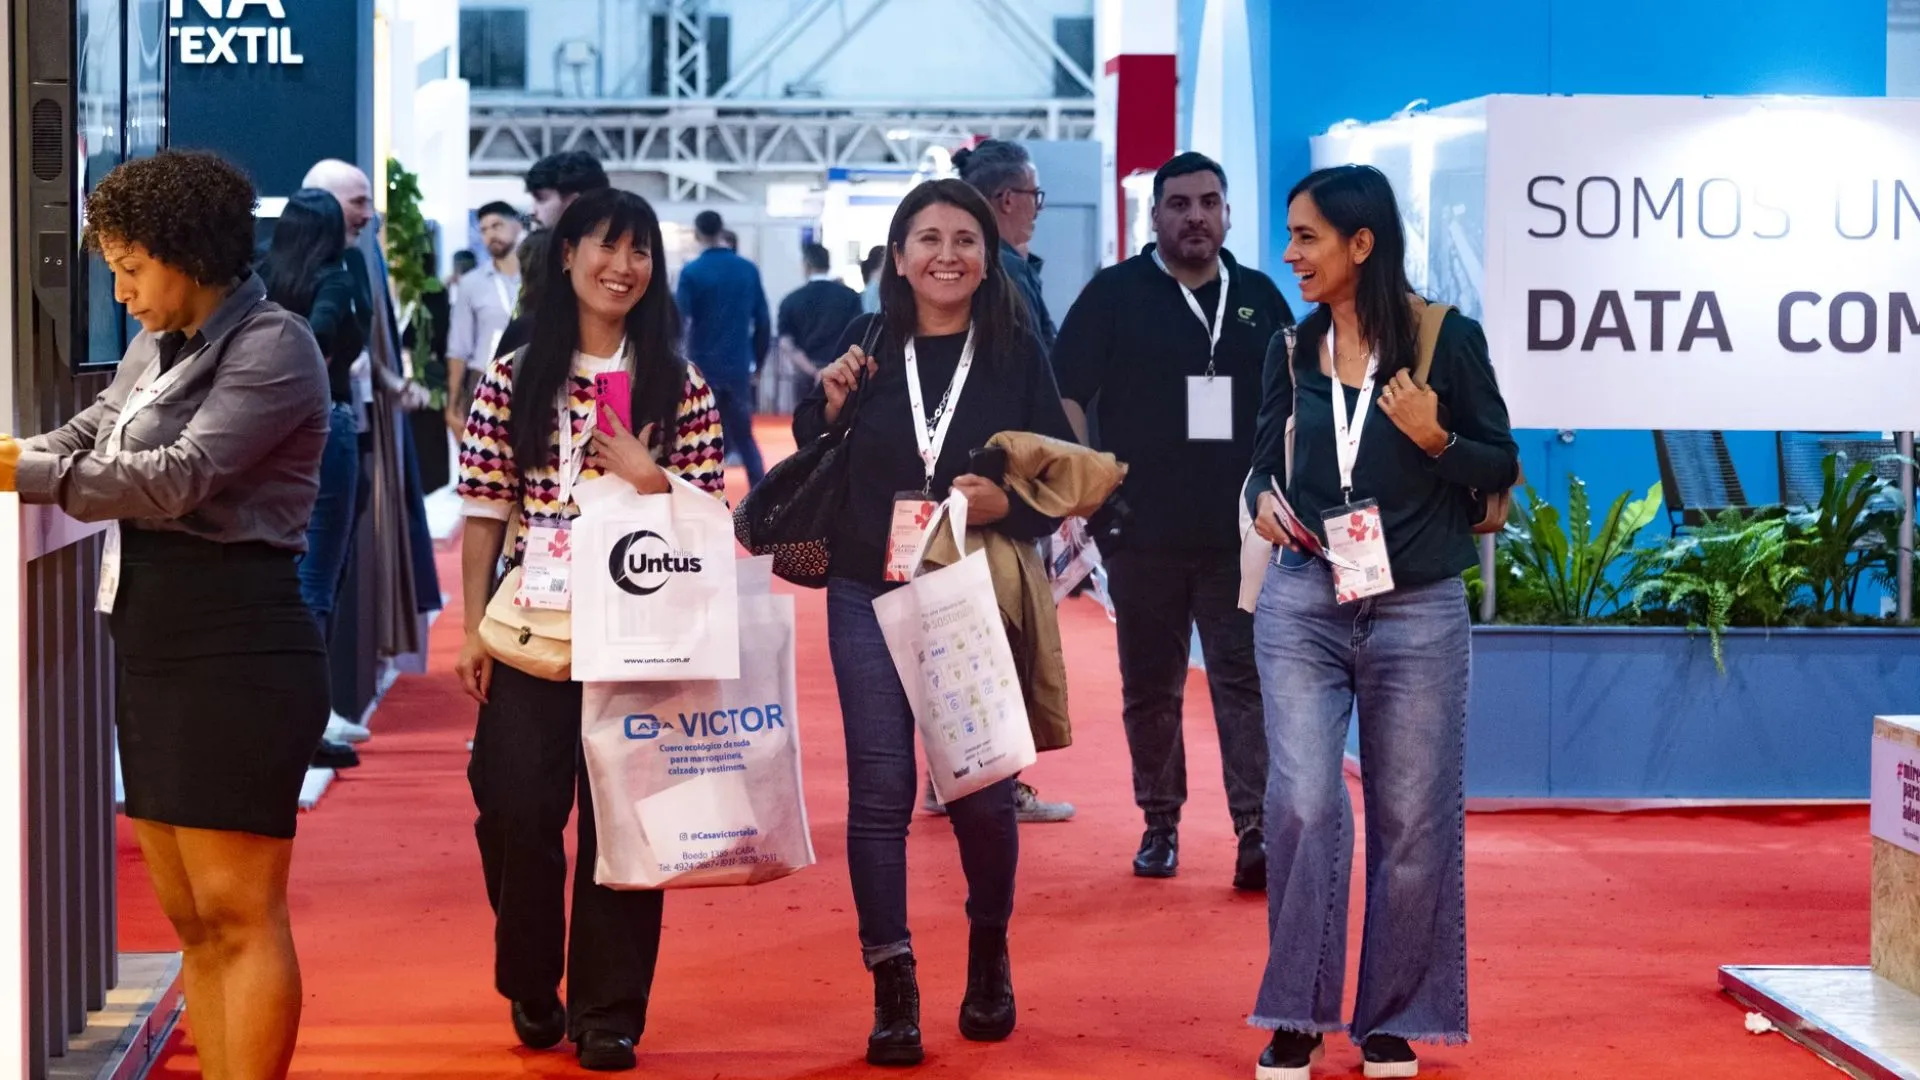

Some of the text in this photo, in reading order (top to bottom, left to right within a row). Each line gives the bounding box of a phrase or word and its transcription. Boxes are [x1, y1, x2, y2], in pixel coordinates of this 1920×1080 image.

[1527, 175, 1791, 239] SOMOS
[1527, 289, 1734, 352] DATA
[629, 553, 703, 574] Untus
[623, 656, 691, 665] www.untus.com.ar
[678, 703, 785, 737] VICTOR
[659, 744, 682, 752] Cuero
[684, 741, 722, 752] ecológico
[670, 756, 689, 765] para
[668, 766, 698, 776] calzado
